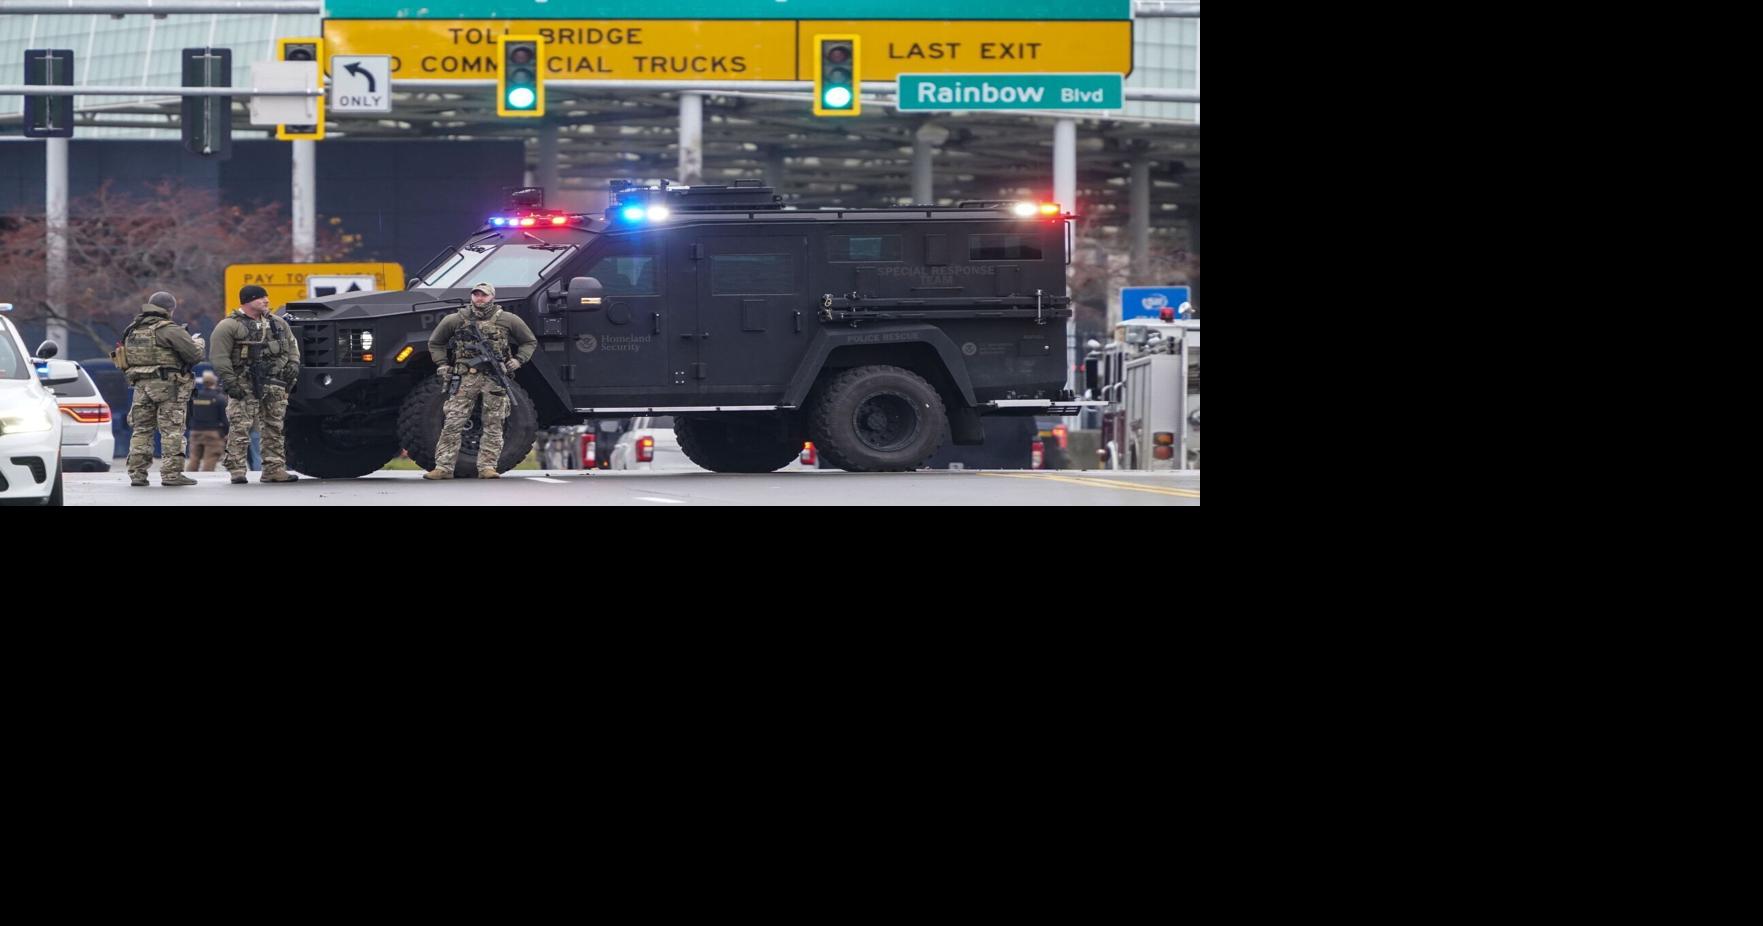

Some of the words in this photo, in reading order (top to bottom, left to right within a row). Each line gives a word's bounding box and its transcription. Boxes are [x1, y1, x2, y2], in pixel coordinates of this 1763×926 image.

[539, 28, 642, 44] BRIDGE
[889, 43, 961, 59] LAST
[980, 43, 1042, 59] EXIT
[421, 56, 613, 73] COMMCIAL
[633, 56, 747, 73] TRUCKS
[917, 82, 1045, 103] Rainbow
[1060, 88, 1104, 102] Blvd
[339, 96, 382, 107] ONLY
[877, 266, 928, 276] SPECIAL
[931, 265, 995, 275] RESPONSE
[243, 273, 274, 284] PAY
[920, 276, 953, 285] TEAM
[601, 334, 651, 344] Homeland
[601, 343, 640, 353] Security
